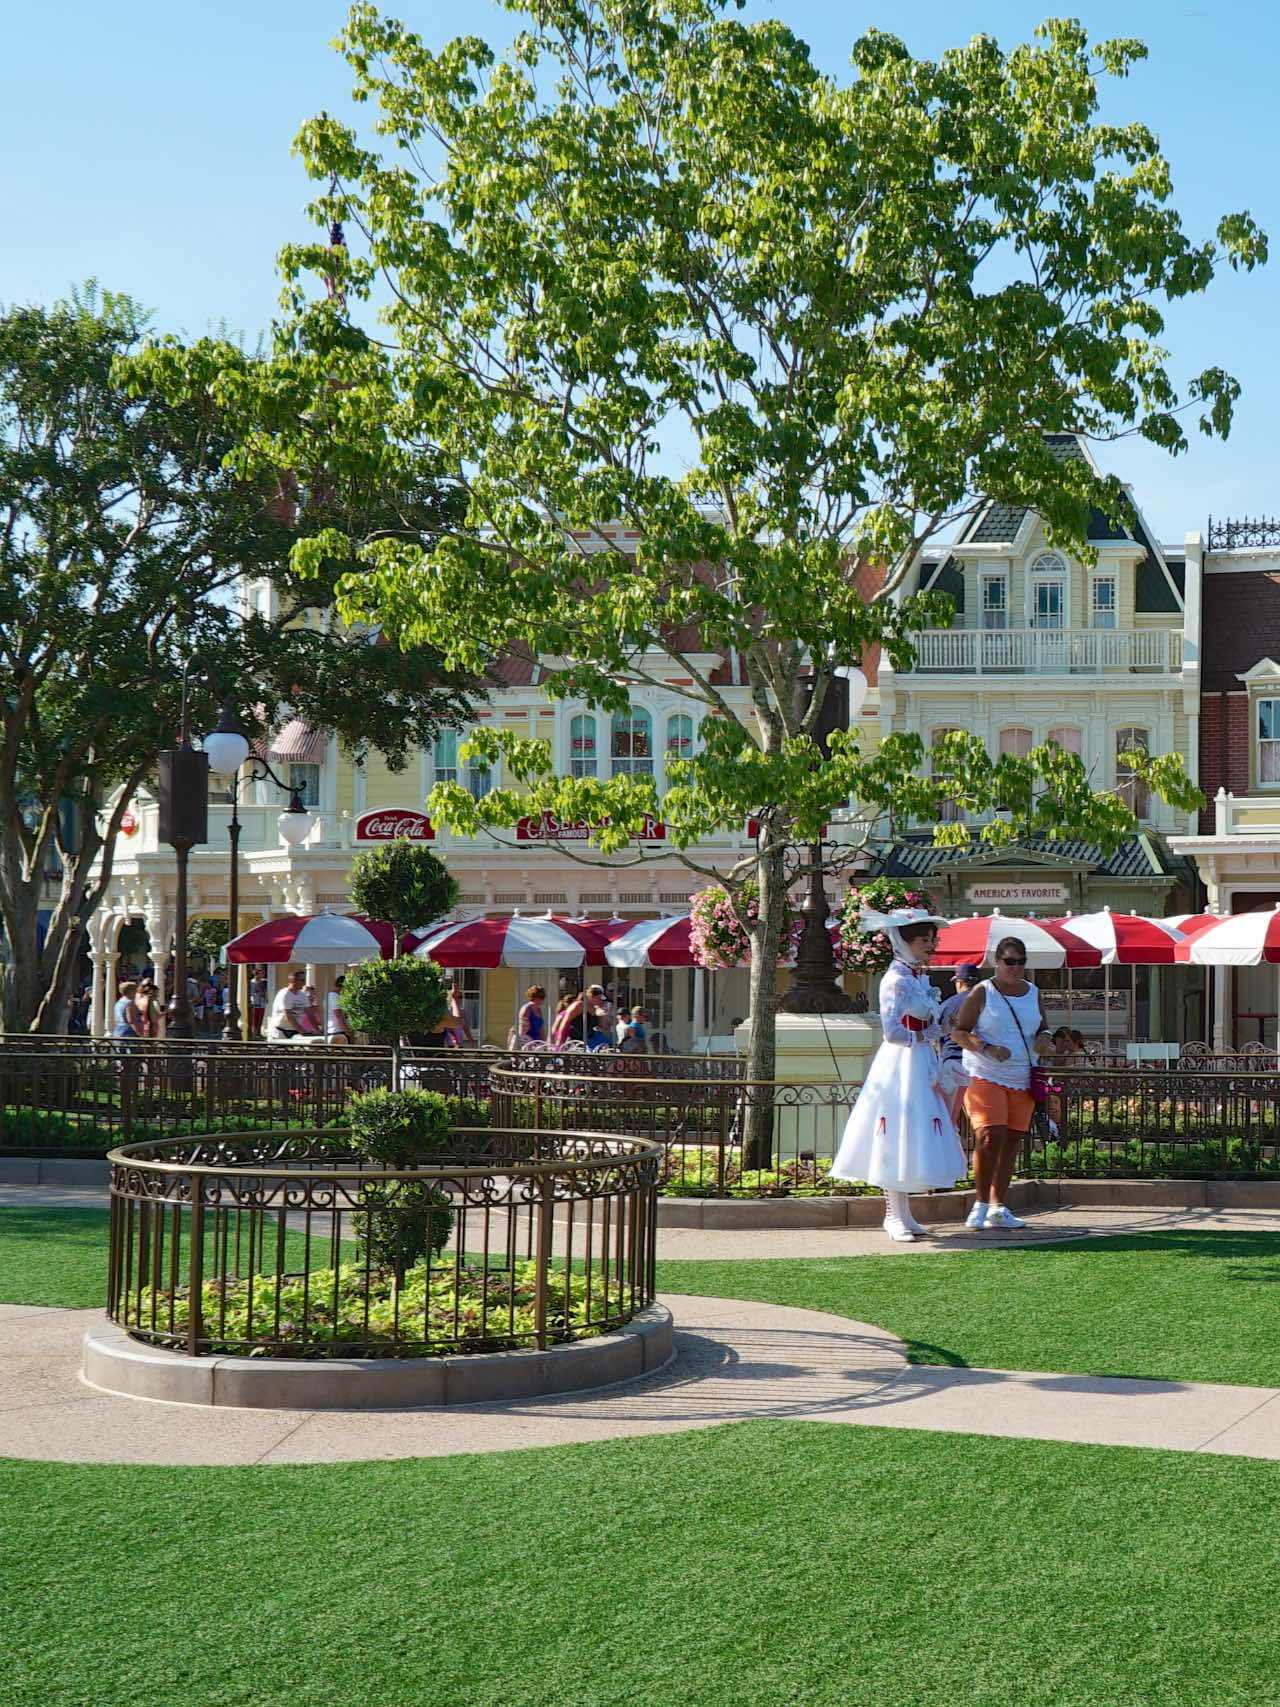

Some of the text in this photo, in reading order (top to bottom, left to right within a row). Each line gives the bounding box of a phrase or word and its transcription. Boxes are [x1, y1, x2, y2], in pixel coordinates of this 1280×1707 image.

[365, 817, 426, 839] Coca-Cola
[526, 813, 588, 839] CASES
[558, 829, 588, 838] FAMOUS
[974, 888, 1061, 898] AMERICA'S FAVORITE
